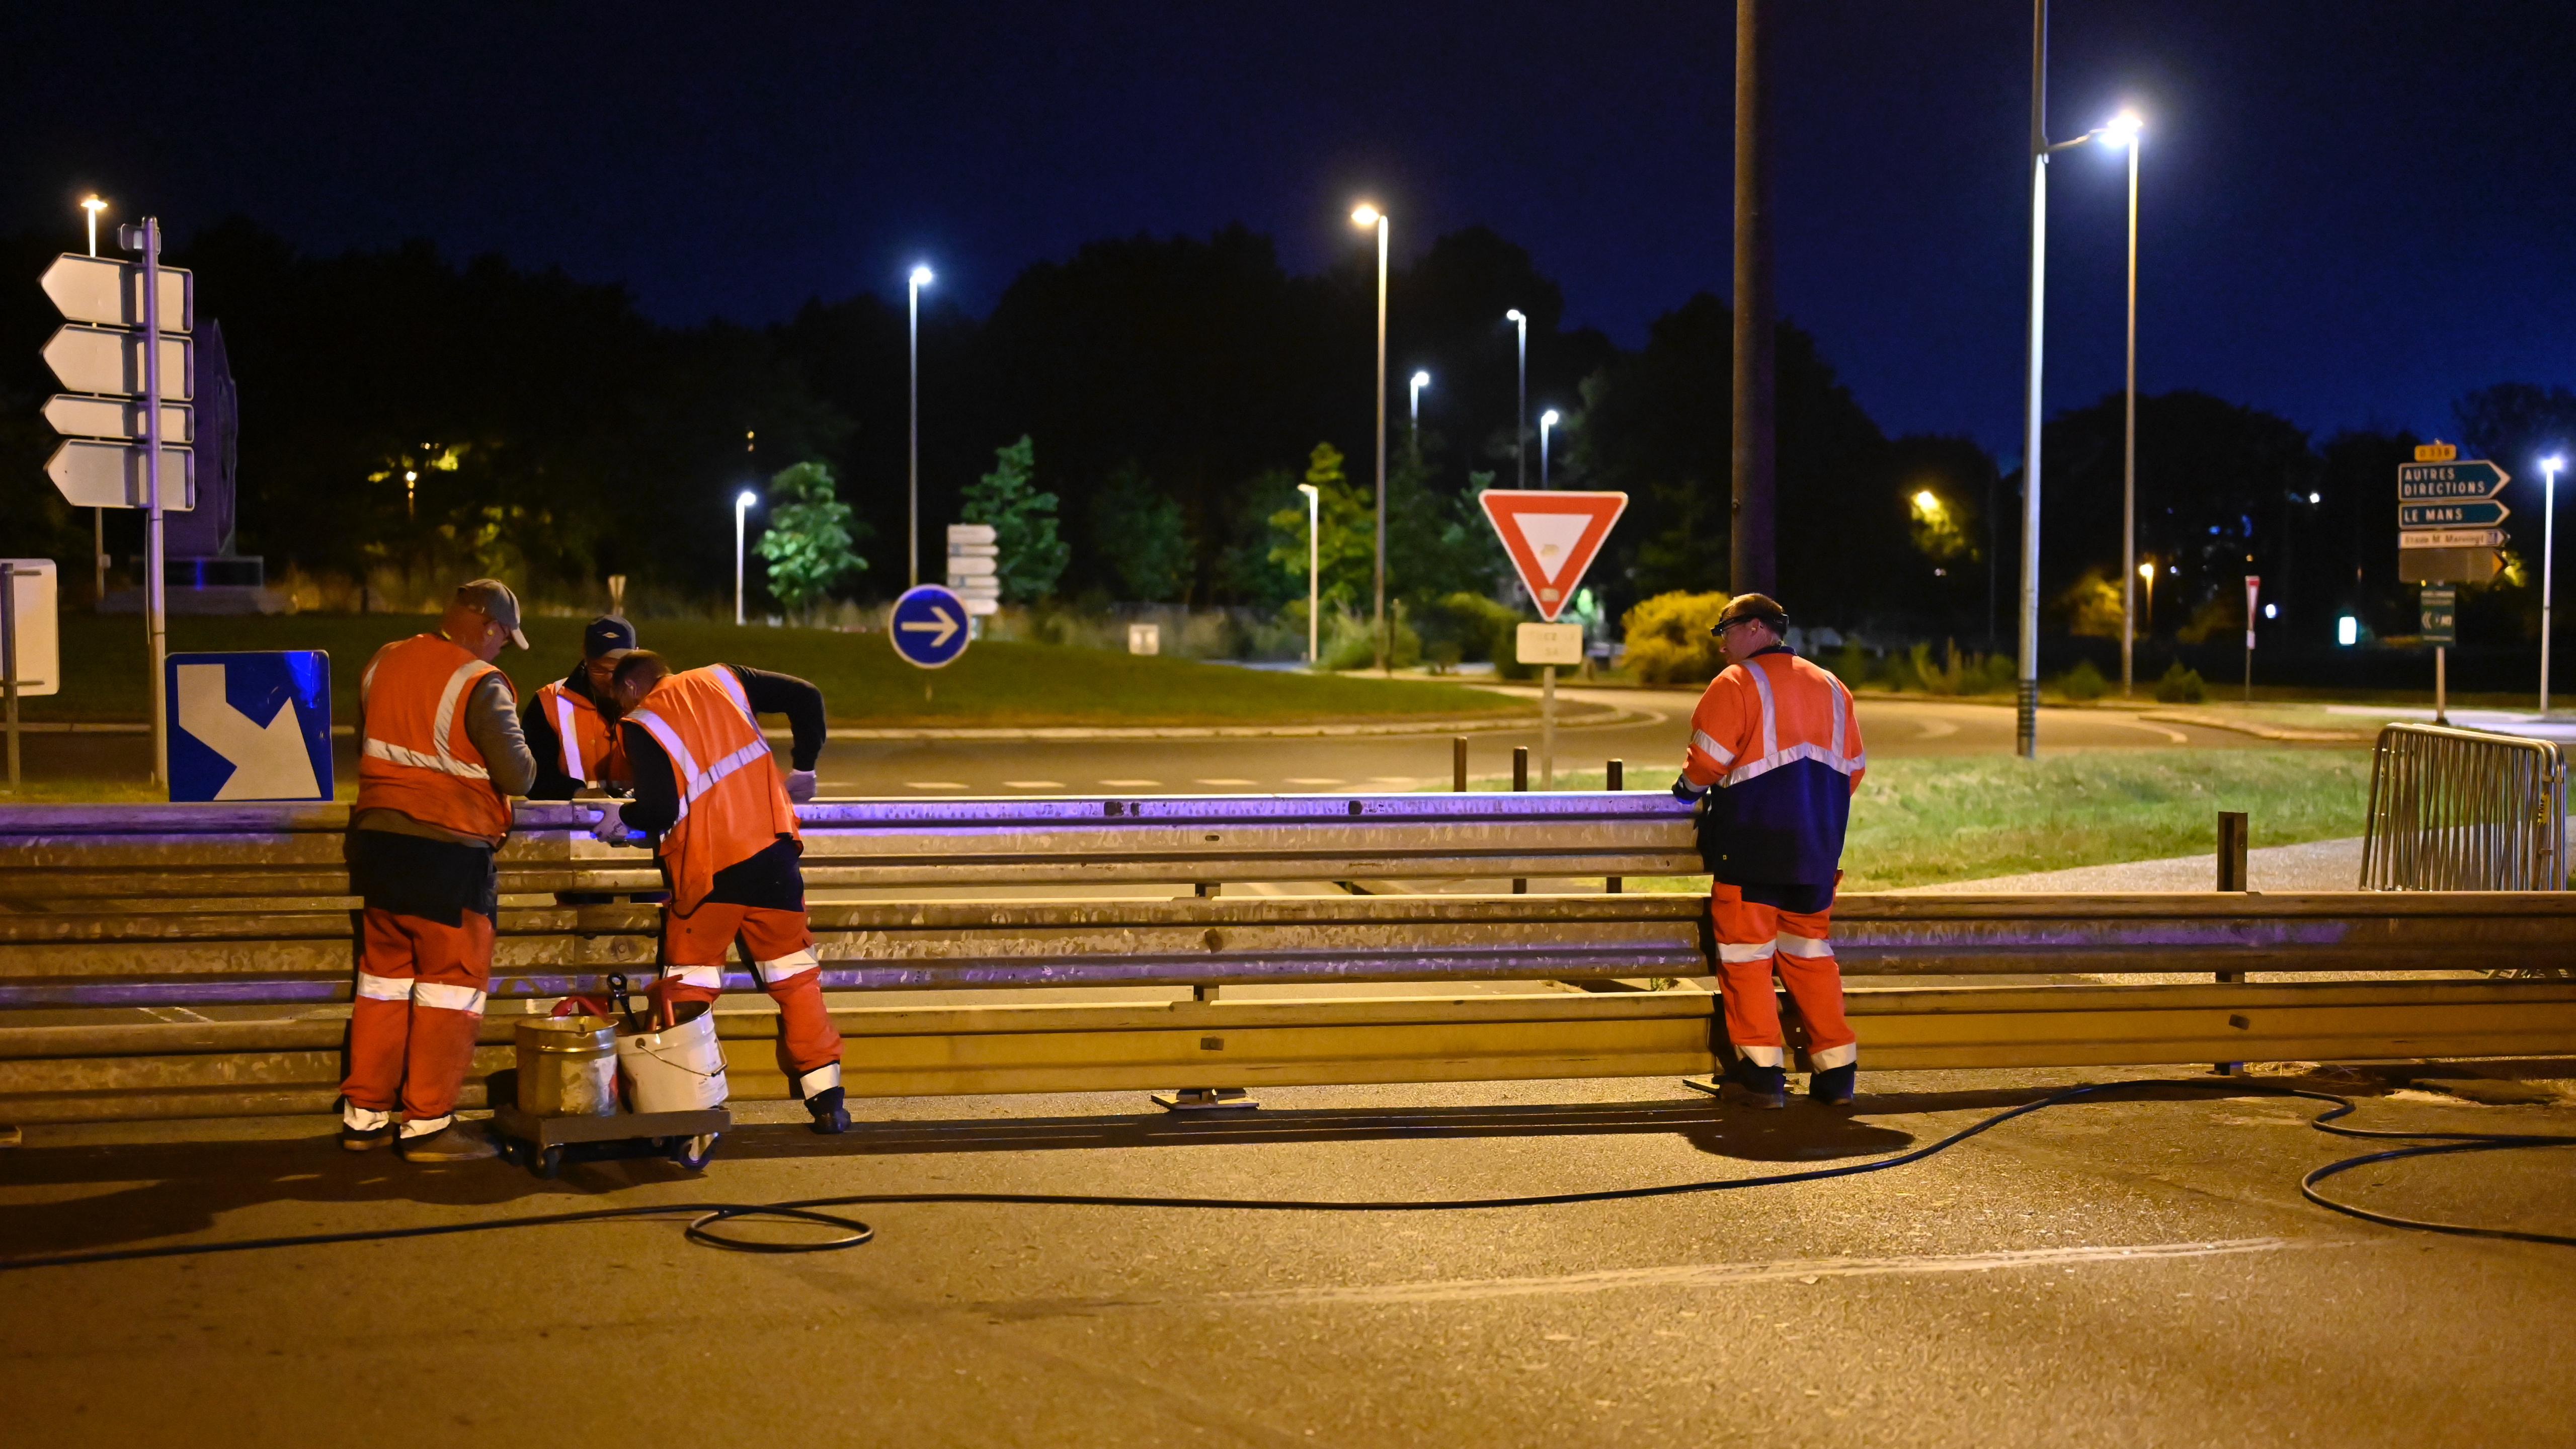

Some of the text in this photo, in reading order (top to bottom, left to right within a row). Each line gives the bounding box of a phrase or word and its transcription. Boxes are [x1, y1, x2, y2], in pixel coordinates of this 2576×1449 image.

[2405, 468, 2455, 481] AUTRES
[2404, 481, 2484, 496] DIRECTIONS
[2404, 508, 2463, 522] LE MANS
